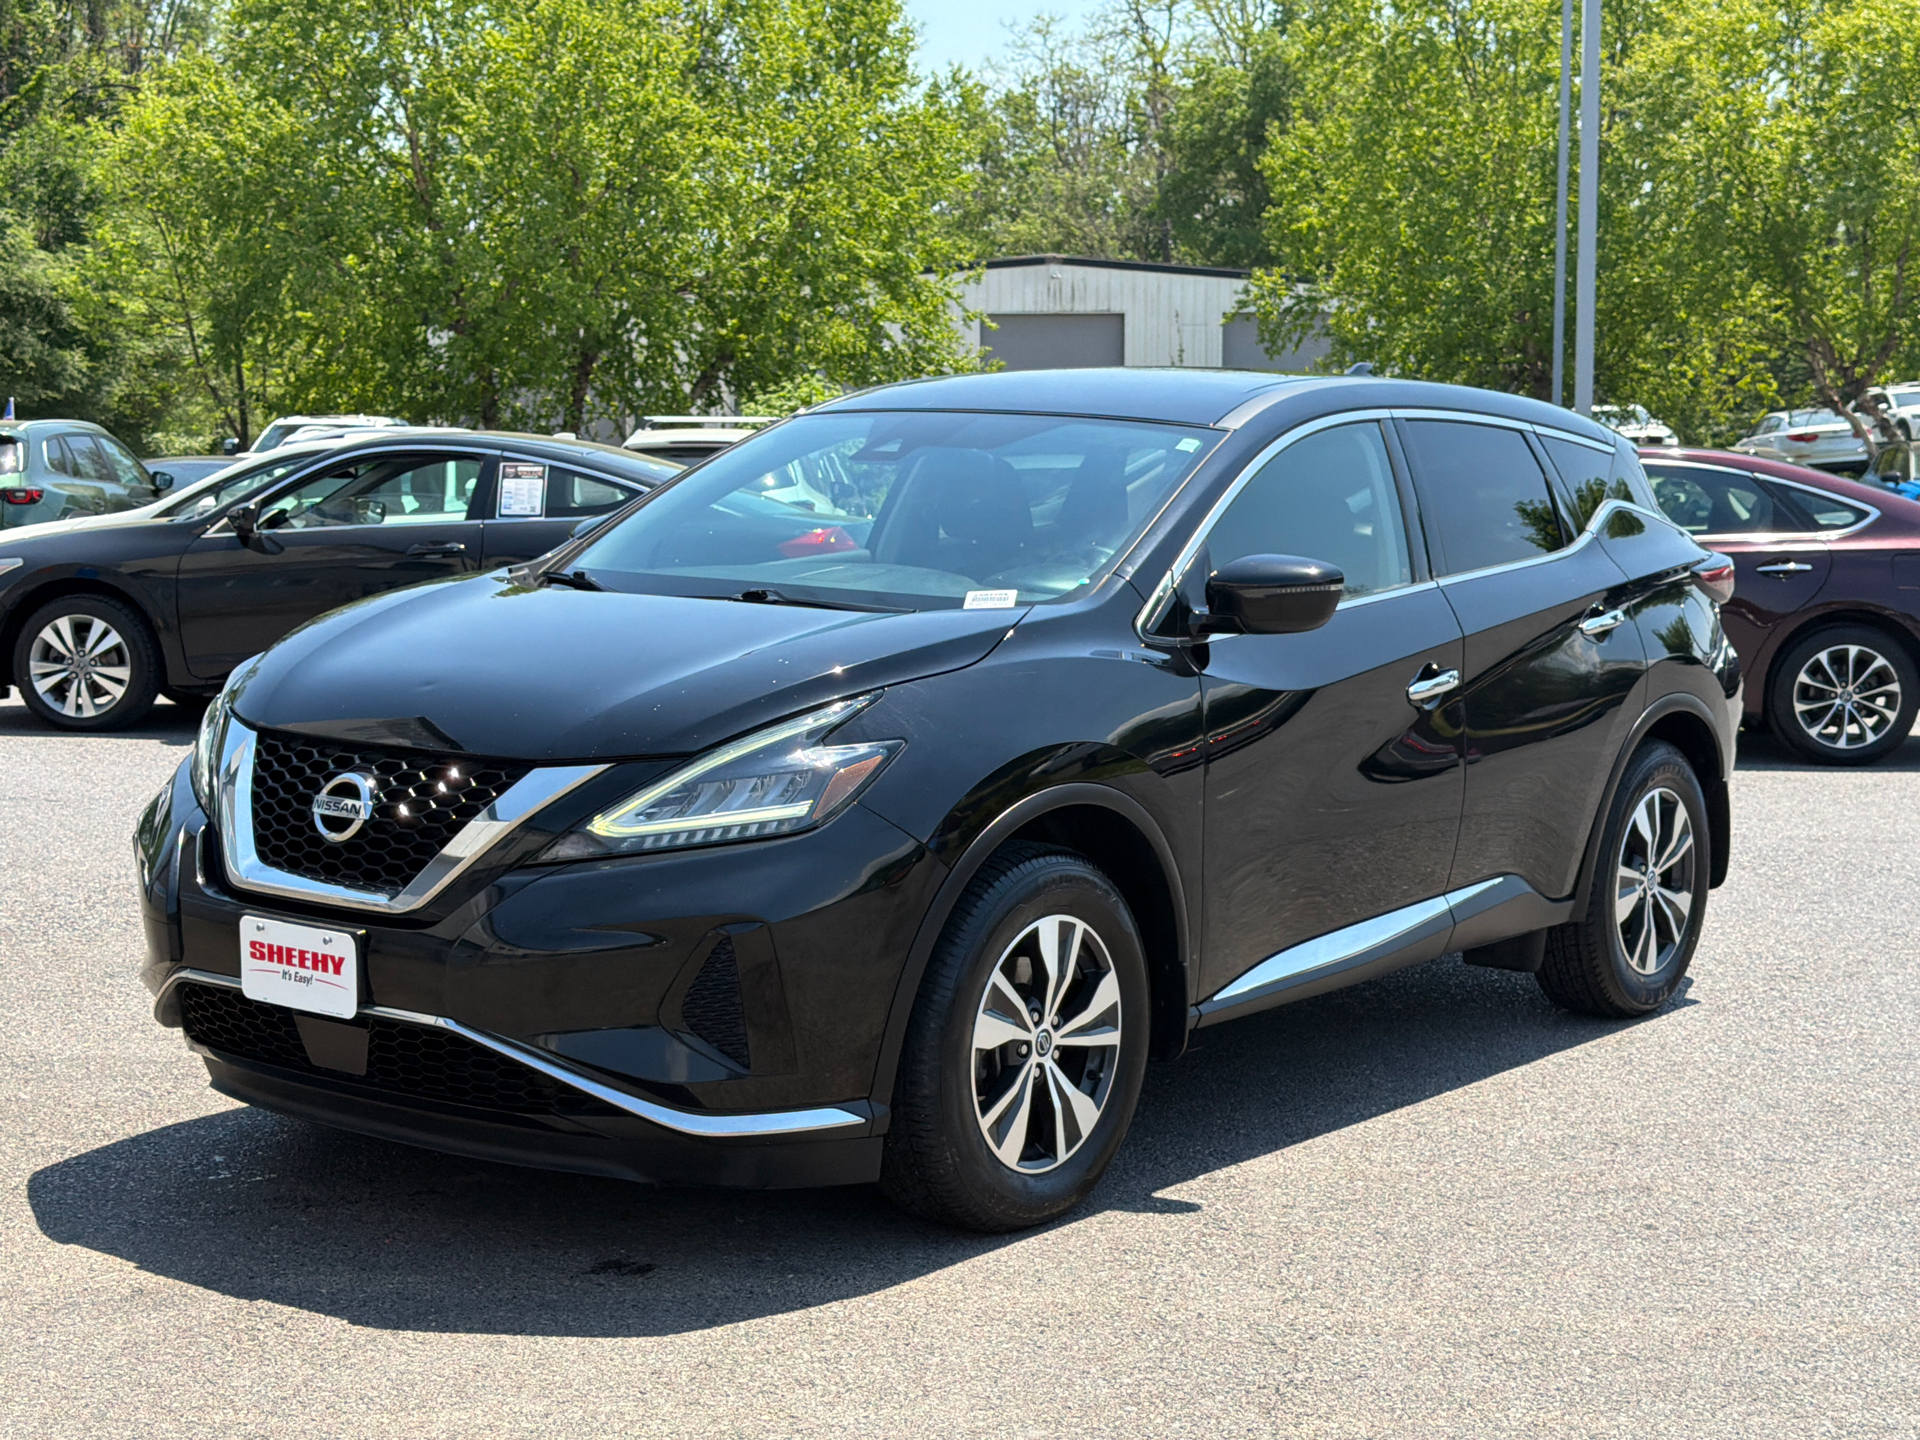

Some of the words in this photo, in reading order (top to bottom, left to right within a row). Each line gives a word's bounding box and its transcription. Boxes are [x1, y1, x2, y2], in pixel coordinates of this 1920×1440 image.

[314, 799, 362, 815] NISSAN
[249, 940, 345, 976] SHEEHY
[281, 969, 292, 981] It's
[294, 971, 314, 987] Easy!
